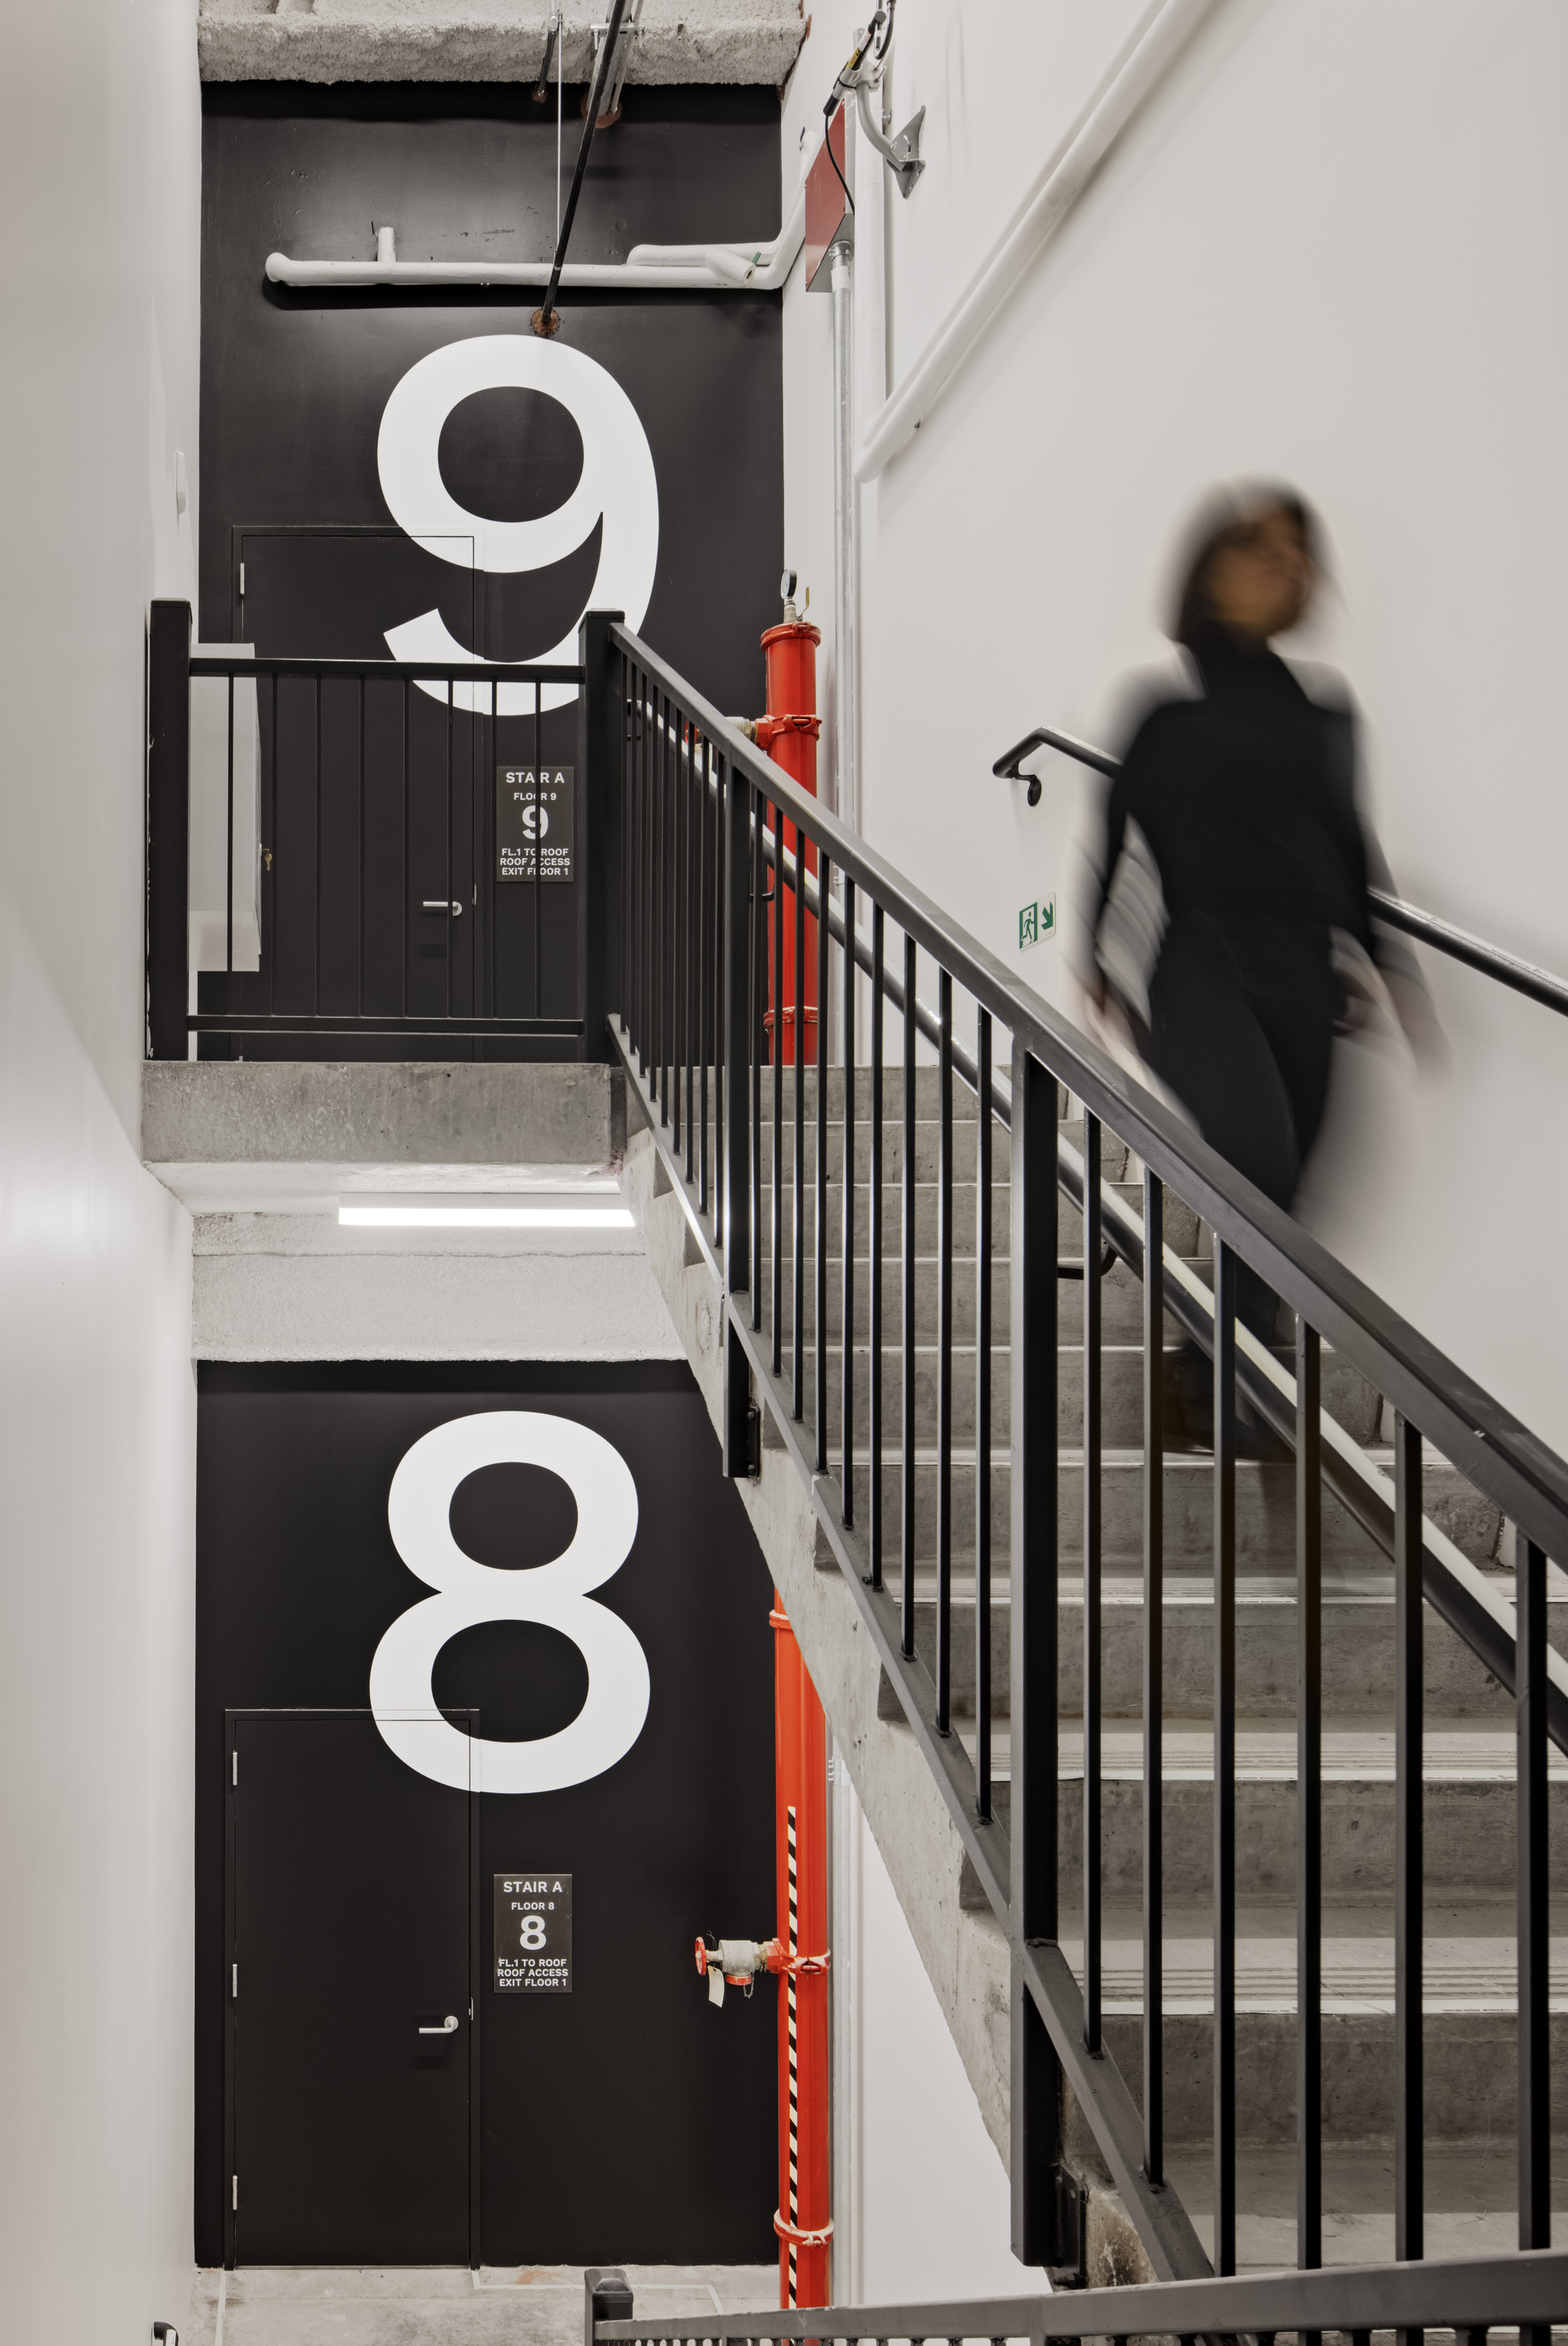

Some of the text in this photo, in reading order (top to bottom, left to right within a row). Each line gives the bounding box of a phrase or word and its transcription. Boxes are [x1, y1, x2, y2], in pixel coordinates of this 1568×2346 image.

[377, 335, 659, 716] 9
[506, 772, 564, 783] STAR A
[550, 792, 557, 801] 9
[522, 804, 548, 839] 9
[502, 848, 521, 856] FL.1
[541, 848, 568, 856] ROOF
[370, 1411, 650, 1793] 8
[503, 1881, 563, 1893] STAIR A
[511, 1902, 555, 1911] FLOOR 8
[520, 1915, 546, 1951] 8
